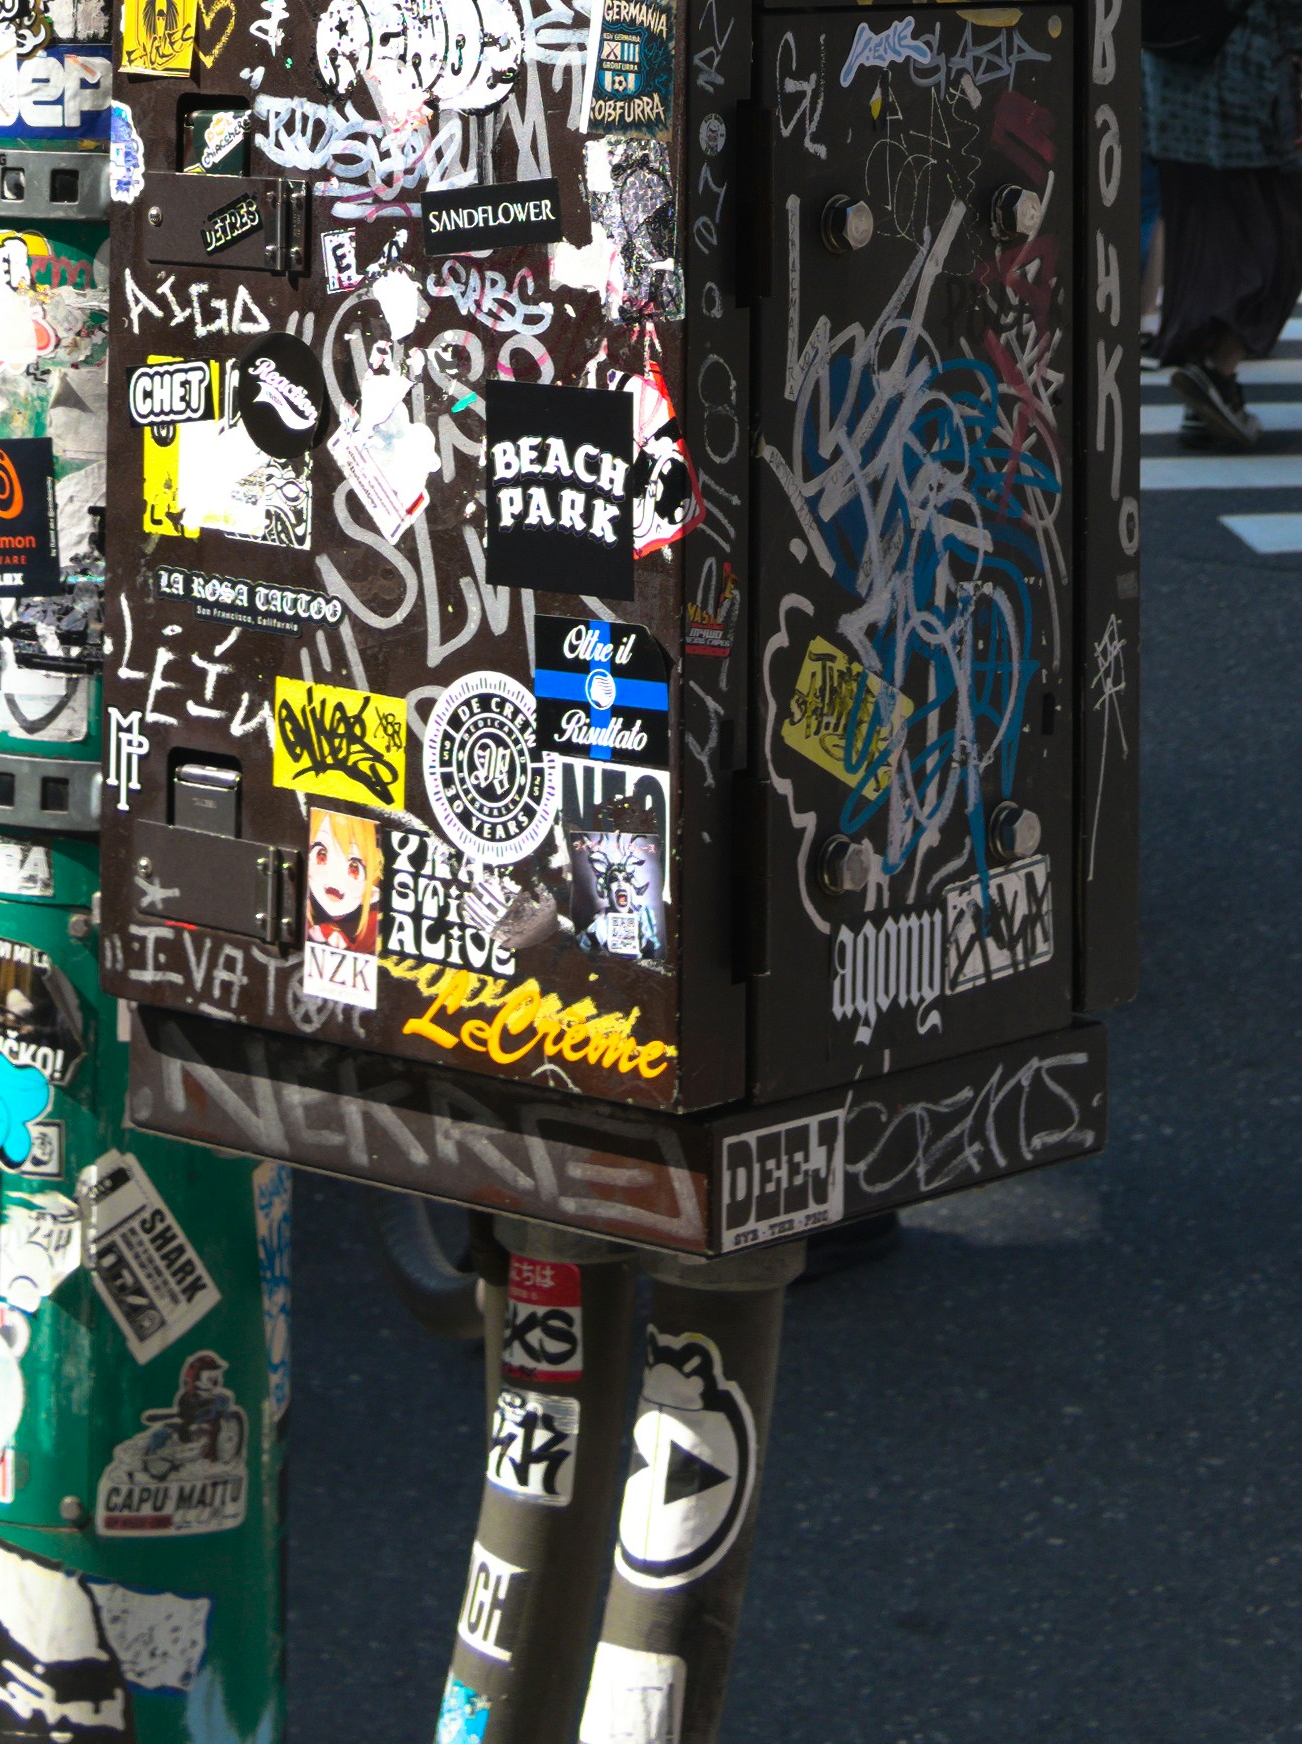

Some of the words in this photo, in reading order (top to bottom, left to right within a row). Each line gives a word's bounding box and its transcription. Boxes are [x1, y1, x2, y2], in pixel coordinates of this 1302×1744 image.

[428, 199, 556, 235] SANDFLOWER
[130, 367, 209, 417] CHET
[250, 357, 317, 424] Reaction
[492, 434, 631, 500] BEACH
[499, 485, 620, 545] PARK
[159, 570, 185, 594] LA
[189, 574, 249, 605] ROSA
[255, 586, 344, 623] TATTOO
[196, 605, 211, 616] San
[256, 617, 299, 632] California
[563, 625, 609, 664] Oltre
[616, 636, 634, 665] il
[455, 699, 477, 721] DE
[488, 695, 536, 748] CREW
[555, 708, 648, 750] Risultato
[470, 812, 527, 838] YEARS
[306, 945, 371, 991] NZK
[832, 907, 944, 1045] agony
[724, 1114, 843, 1232] DEEJ
[139, 1206, 211, 1305] SHARK
[105, 1480, 171, 1512] CAPU
